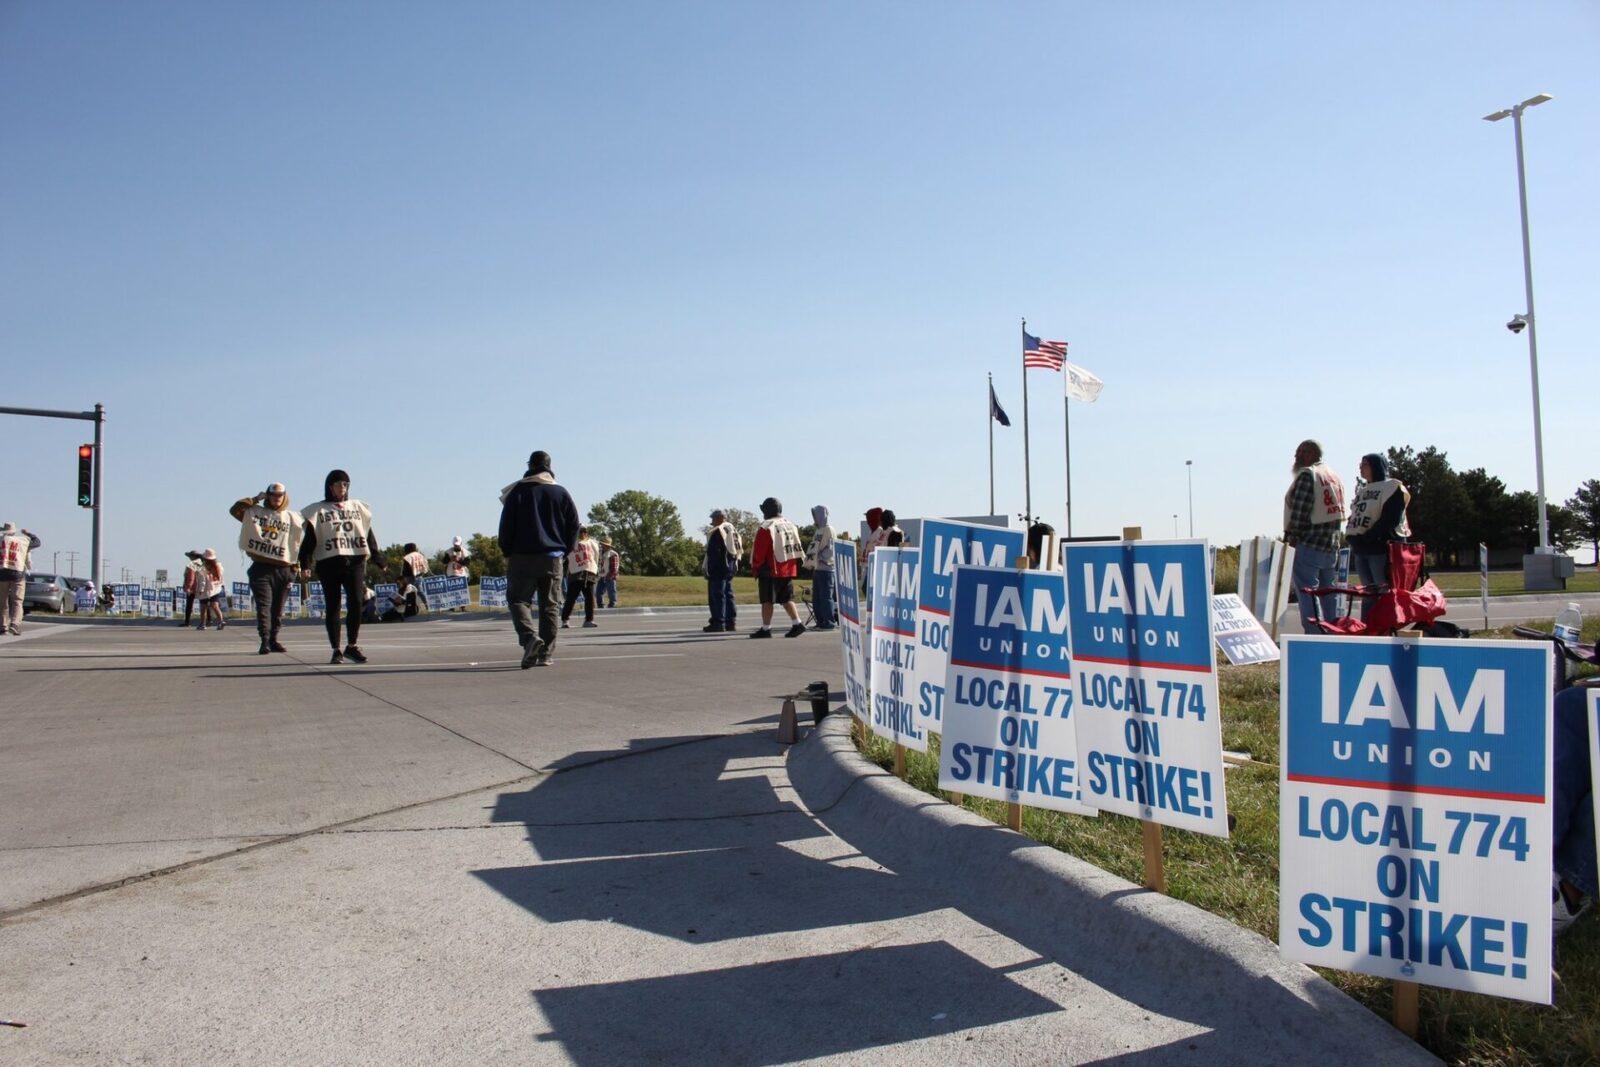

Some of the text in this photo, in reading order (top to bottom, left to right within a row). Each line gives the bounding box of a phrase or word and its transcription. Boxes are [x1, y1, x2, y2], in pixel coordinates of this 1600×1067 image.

[325, 536, 367, 551] STRIKE
[332, 521, 354, 532] 70
[248, 539, 286, 557] STRIKE
[933, 535, 1007, 577] IAM
[881, 561, 919, 600] IAM
[1083, 562, 1185, 617] IAM
[882, 605, 916, 622] UNION
[973, 583, 1069, 635] IAM
[1212, 596, 1241, 611] STRI
[1218, 610, 1234, 620] ON
[921, 619, 949, 653] LOC
[979, 637, 1070, 661] UNION
[1093, 626, 1181, 648] UNION
[1230, 641, 1274, 660] IAM
[875, 637, 903, 669] LOCAL
[904, 643, 915, 671] 77
[890, 670, 904, 697] ON
[955, 675, 1037, 715] LOCAL
[1043, 686, 1074, 719] 77
[1079, 672, 1206, 722] LOCAL 774
[1321, 662, 1505, 735] IAM
[1000, 716, 1039, 750] ON
[1124, 717, 1160, 757] ON
[1332, 740, 1491, 772] UNION
[1087, 750, 1214, 820] STRIKE!
[1298, 795, 1530, 862] LOCAL 774
[1376, 854, 1440, 904] ON
[1298, 892, 1529, 980] STRIKE!
